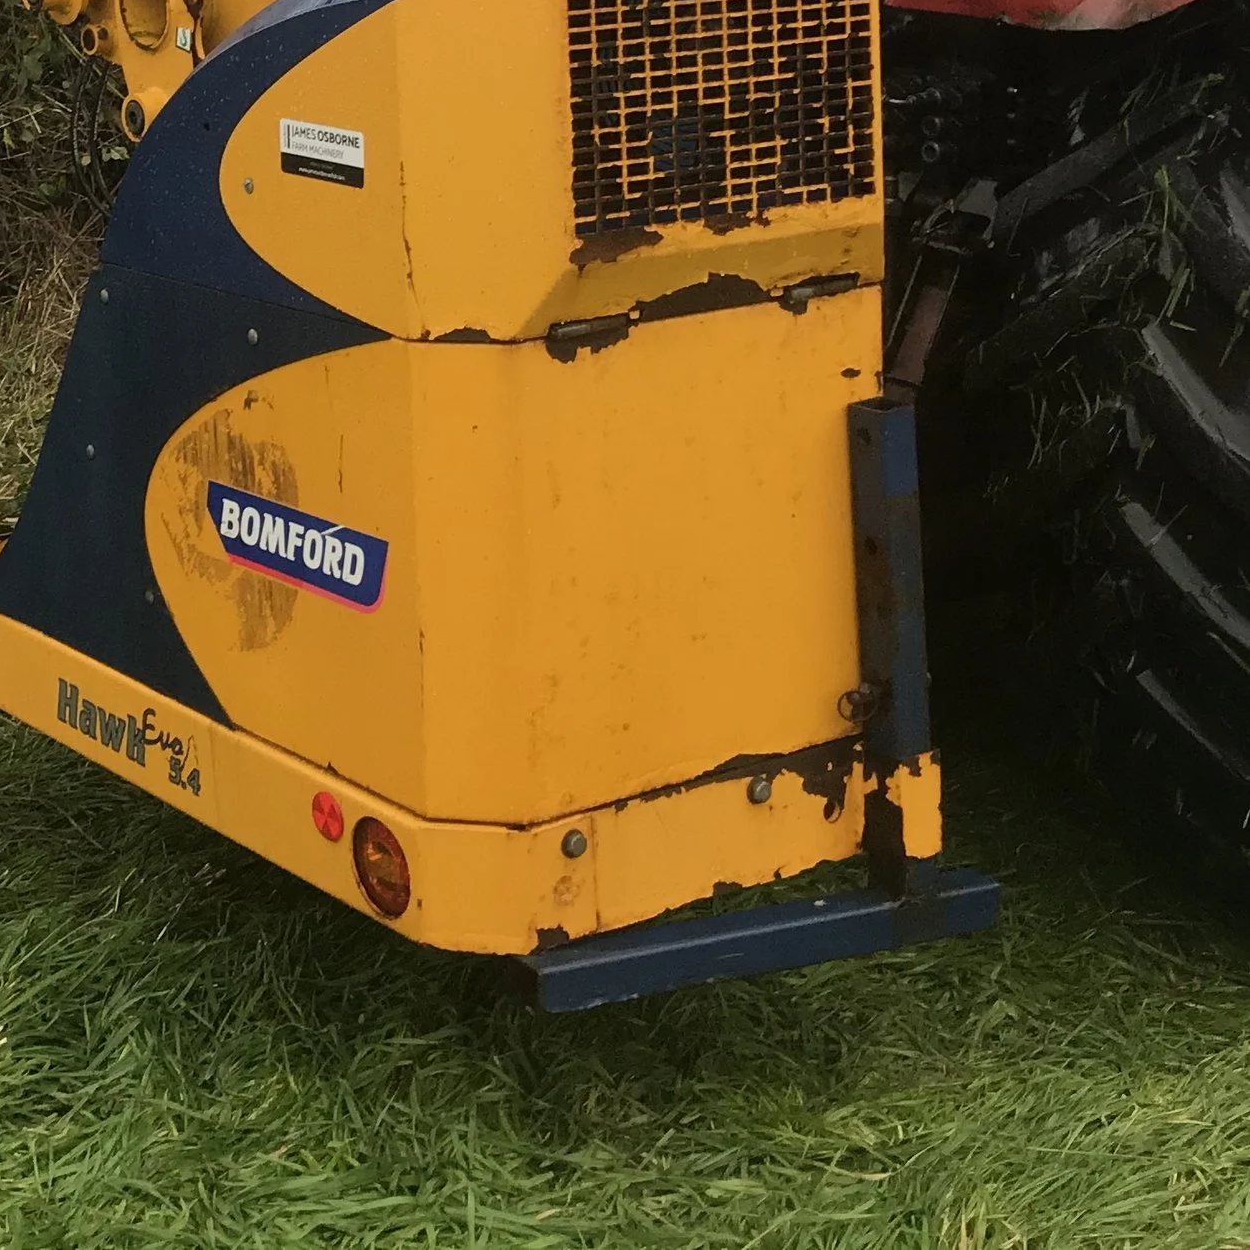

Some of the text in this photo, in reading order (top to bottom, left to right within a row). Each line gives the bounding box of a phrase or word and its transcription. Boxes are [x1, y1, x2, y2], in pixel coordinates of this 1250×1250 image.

[291, 124, 317, 141] JAMES
[317, 130, 361, 149] OSBORNE
[291, 141, 345, 160] FARM MACHINERY
[219, 497, 366, 587] BOMFORD
[57, 677, 202, 798] Hawk Evo 5.4
